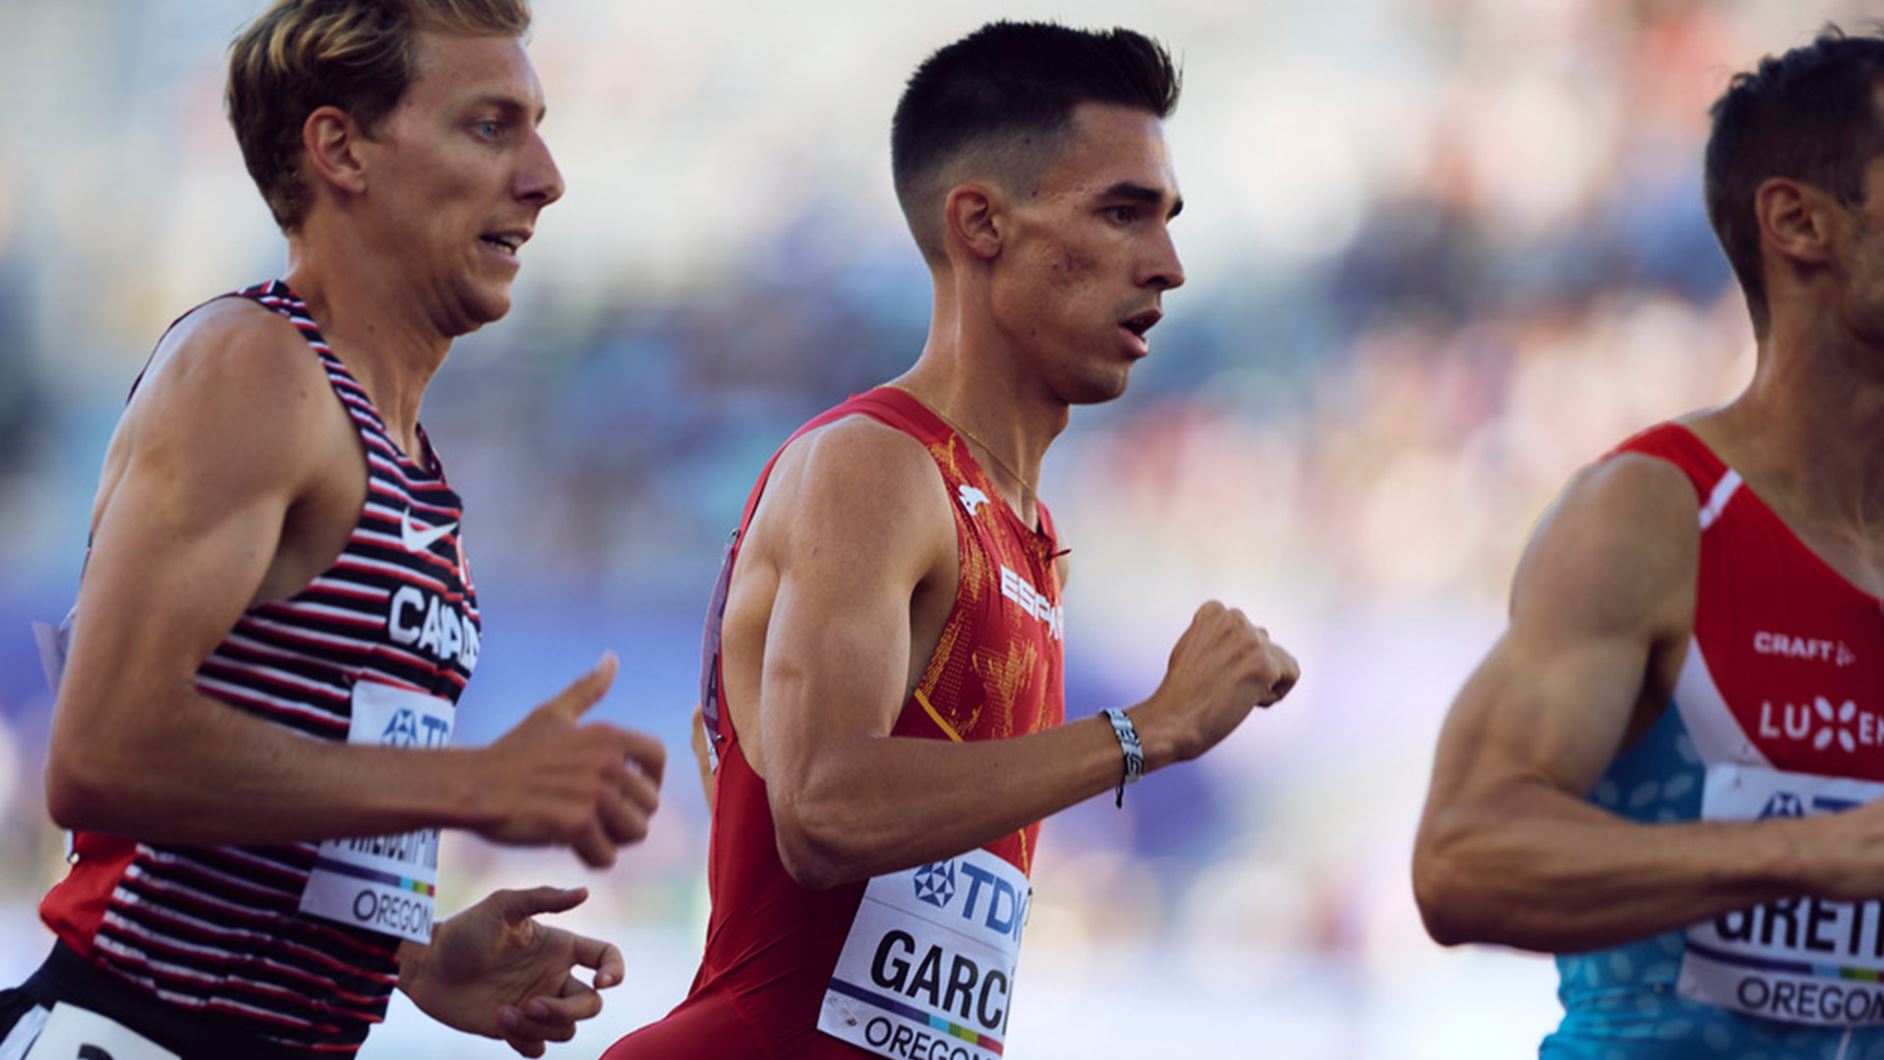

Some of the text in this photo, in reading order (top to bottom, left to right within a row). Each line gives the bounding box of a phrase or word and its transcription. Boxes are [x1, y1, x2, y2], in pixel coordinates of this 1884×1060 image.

[1754, 630, 1834, 662] CRAFT
[1759, 696, 1884, 752] LUXE
[353, 889, 432, 938] OREGON
[865, 1016, 993, 1060] OREG
